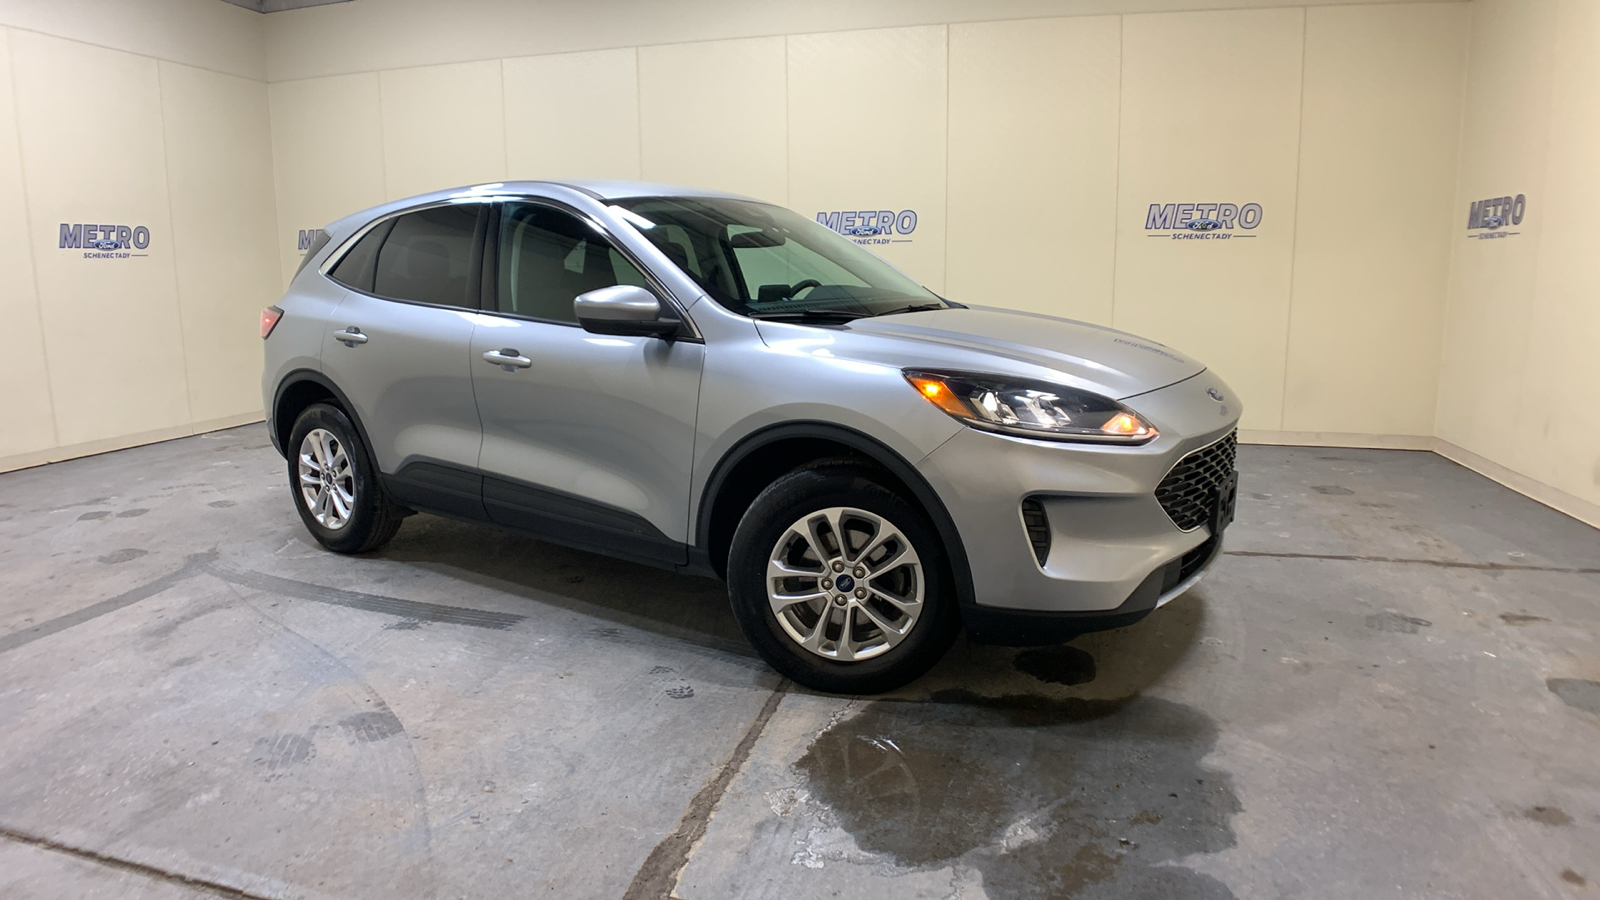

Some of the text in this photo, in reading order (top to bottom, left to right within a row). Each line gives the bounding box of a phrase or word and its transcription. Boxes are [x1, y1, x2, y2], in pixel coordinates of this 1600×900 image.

[816, 209, 918, 236] METRO
[1145, 202, 1263, 230] METRO
[1467, 193, 1526, 230] METRO
[59, 223, 150, 250] METRO
